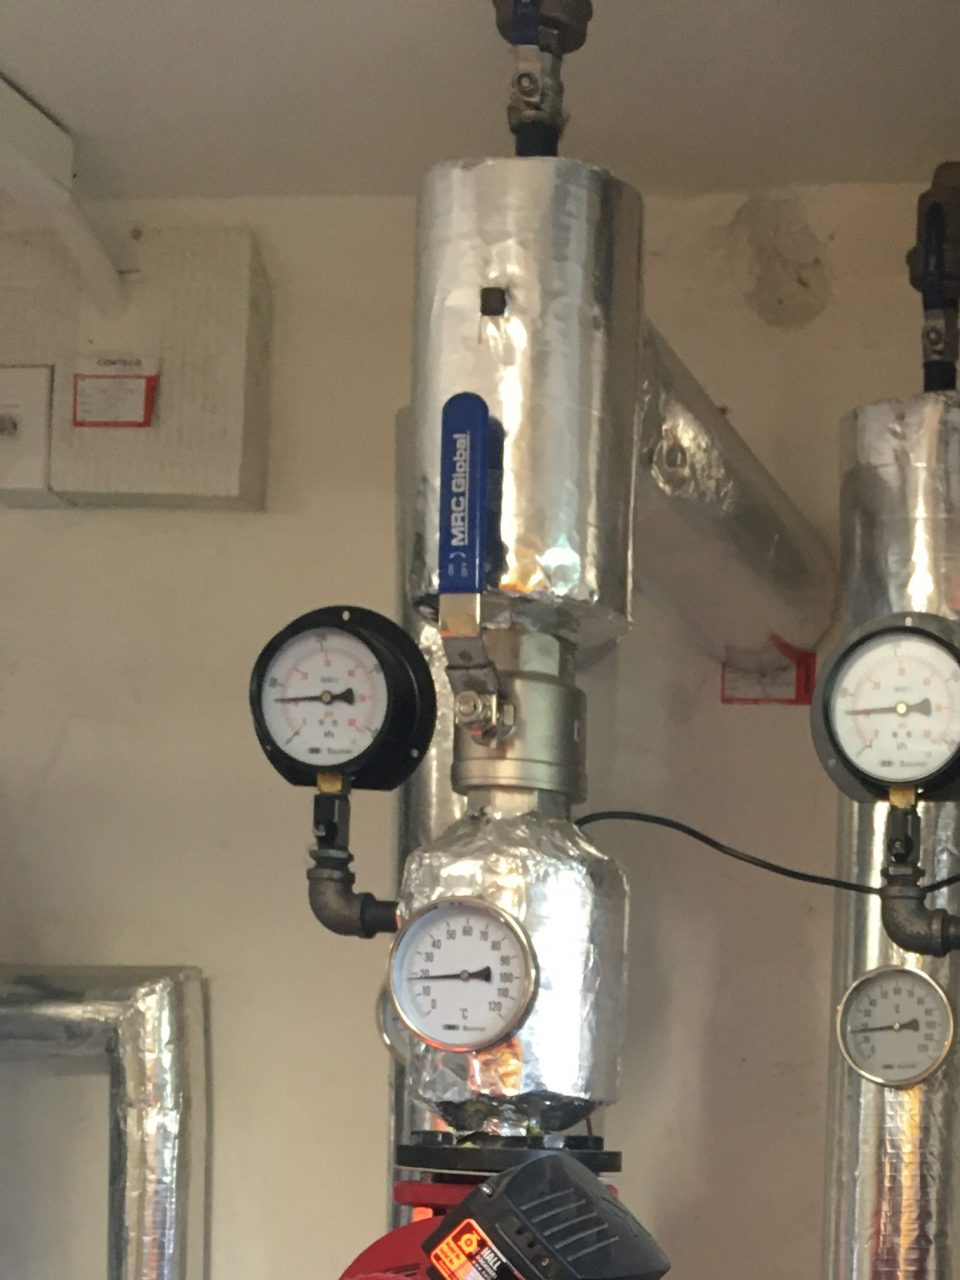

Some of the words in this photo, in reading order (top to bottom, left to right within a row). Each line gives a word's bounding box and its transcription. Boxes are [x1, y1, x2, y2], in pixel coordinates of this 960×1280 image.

[452, 433, 467, 493] Global
[451, 496, 465, 547] MRC
[446, 929, 457, 941] 50
[462, 926, 473, 937] 60
[479, 930, 489, 941] 70
[431, 939, 442, 950] 40
[491, 940, 501, 951] 80
[424, 951, 435, 963] 30
[500, 955, 511, 966] 90
[499, 972, 514, 983] 100
[422, 985, 431, 997] 10
[497, 987, 509, 998] 110
[430, 999, 437, 1010] 0
[488, 1001, 503, 1012] 120
[479, 1245, 503, 1271] HALL
